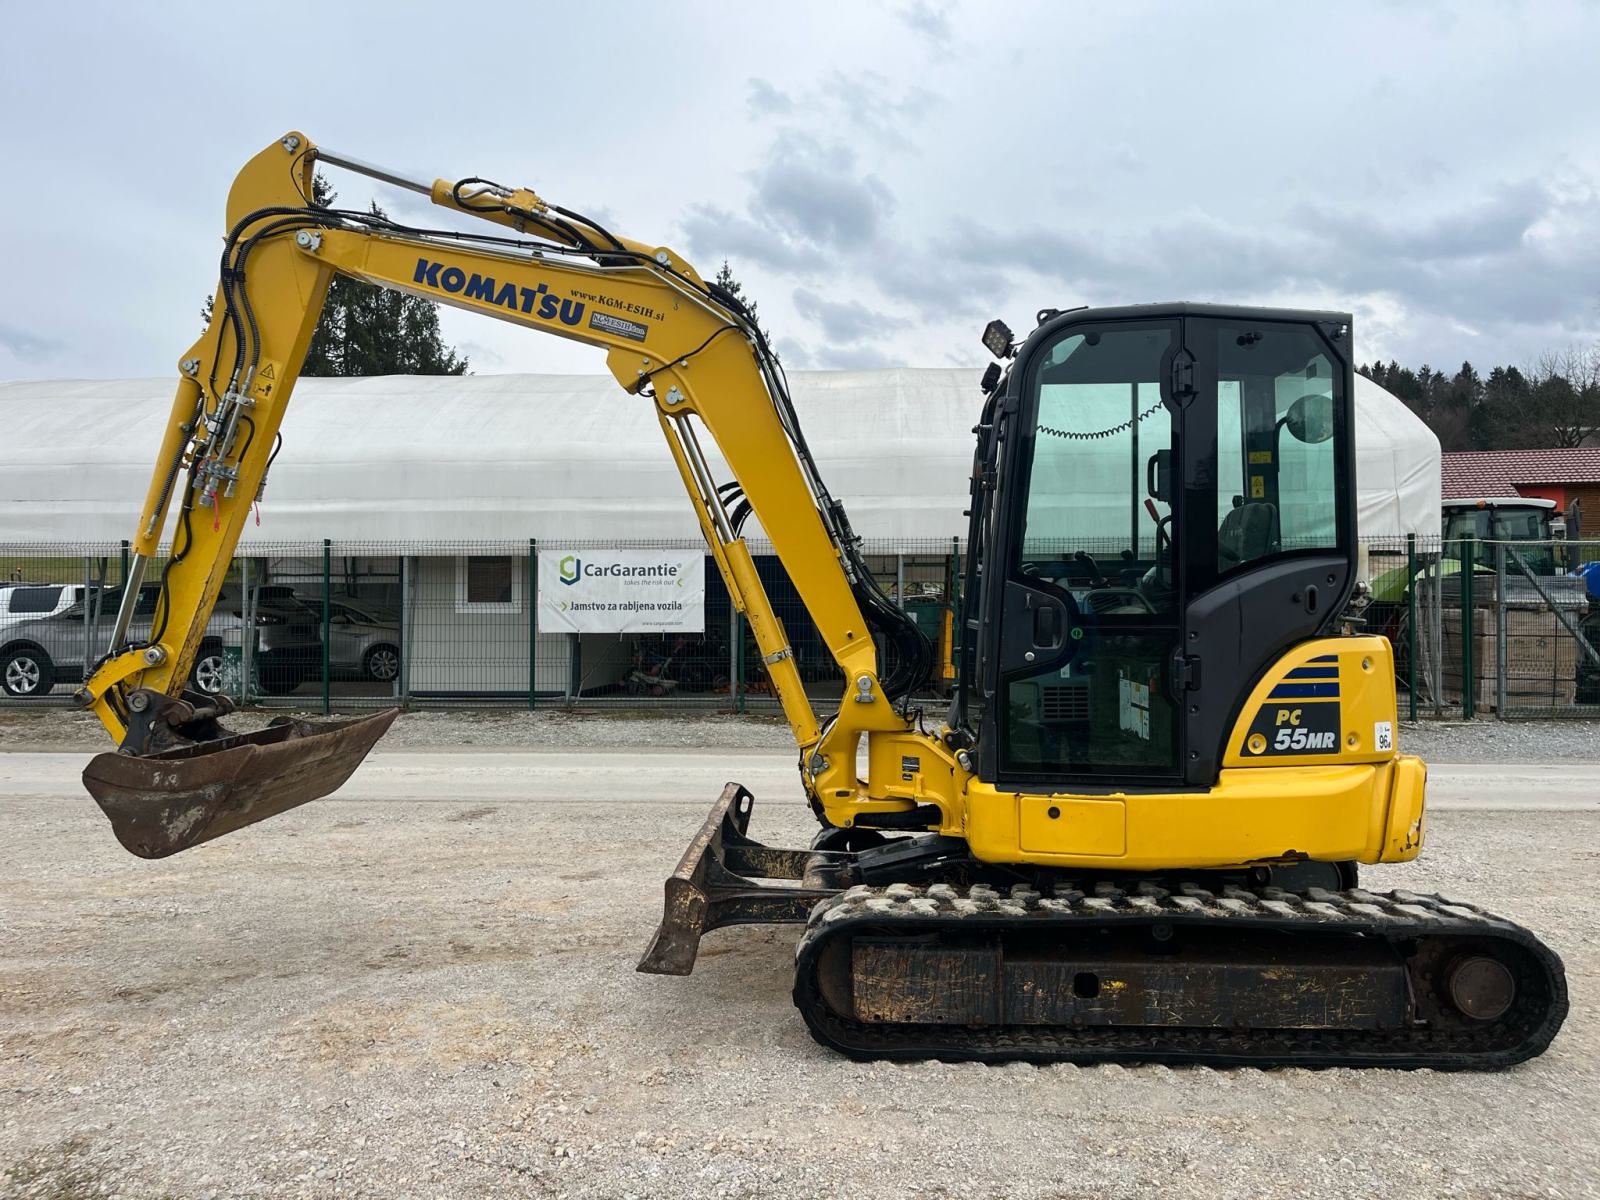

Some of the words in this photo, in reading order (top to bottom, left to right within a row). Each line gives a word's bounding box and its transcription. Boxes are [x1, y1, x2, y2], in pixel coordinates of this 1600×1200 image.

[413, 258, 585, 326] KOMATSU
[570, 289, 665, 321] www.KGM-ESIH.si
[570, 601, 606, 611] Jamstvo
[607, 603, 617, 611] za
[619, 601, 655, 613] rabljena
[657, 601, 682, 611] vozila
[1275, 709, 1302, 726] PC
[1274, 728, 1335, 750] 55MR
